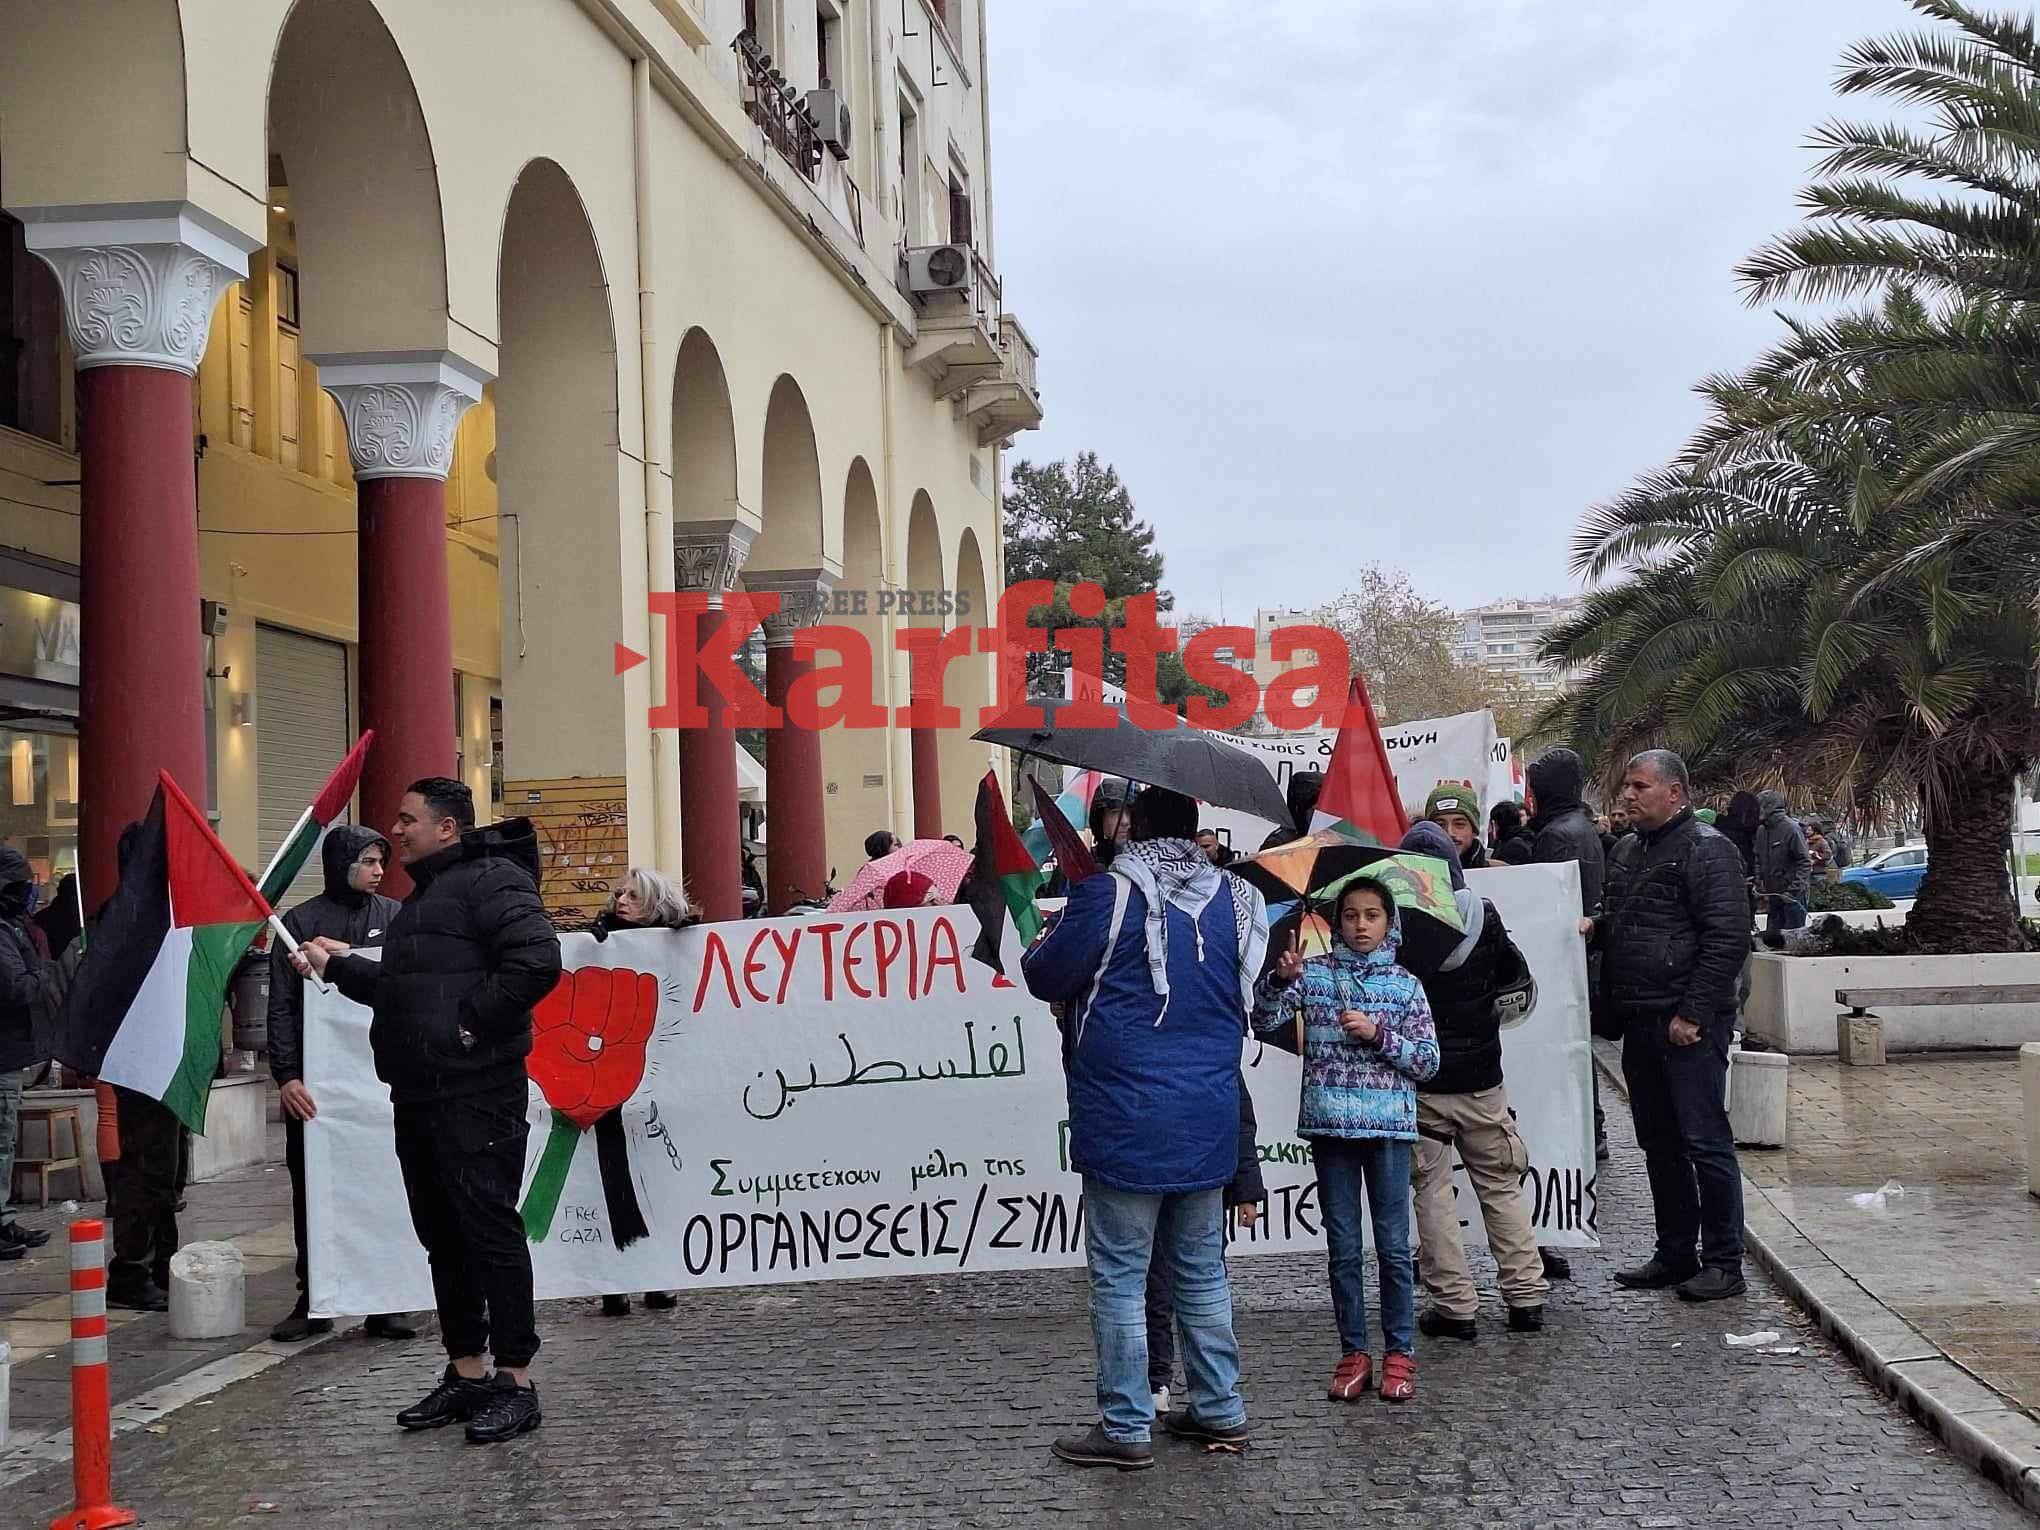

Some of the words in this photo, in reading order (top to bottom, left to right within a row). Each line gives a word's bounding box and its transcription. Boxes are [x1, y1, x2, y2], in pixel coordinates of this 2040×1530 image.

[693, 917, 966, 1012] ΛΕΥΤΕΡΙΑ
[709, 1158, 881, 1206] Συμμετέχουν
[911, 1149, 968, 1191] μέλη
[984, 1157, 1026, 1176] της
[564, 1205, 600, 1221] FREE
[560, 1228, 602, 1244] GAZA
